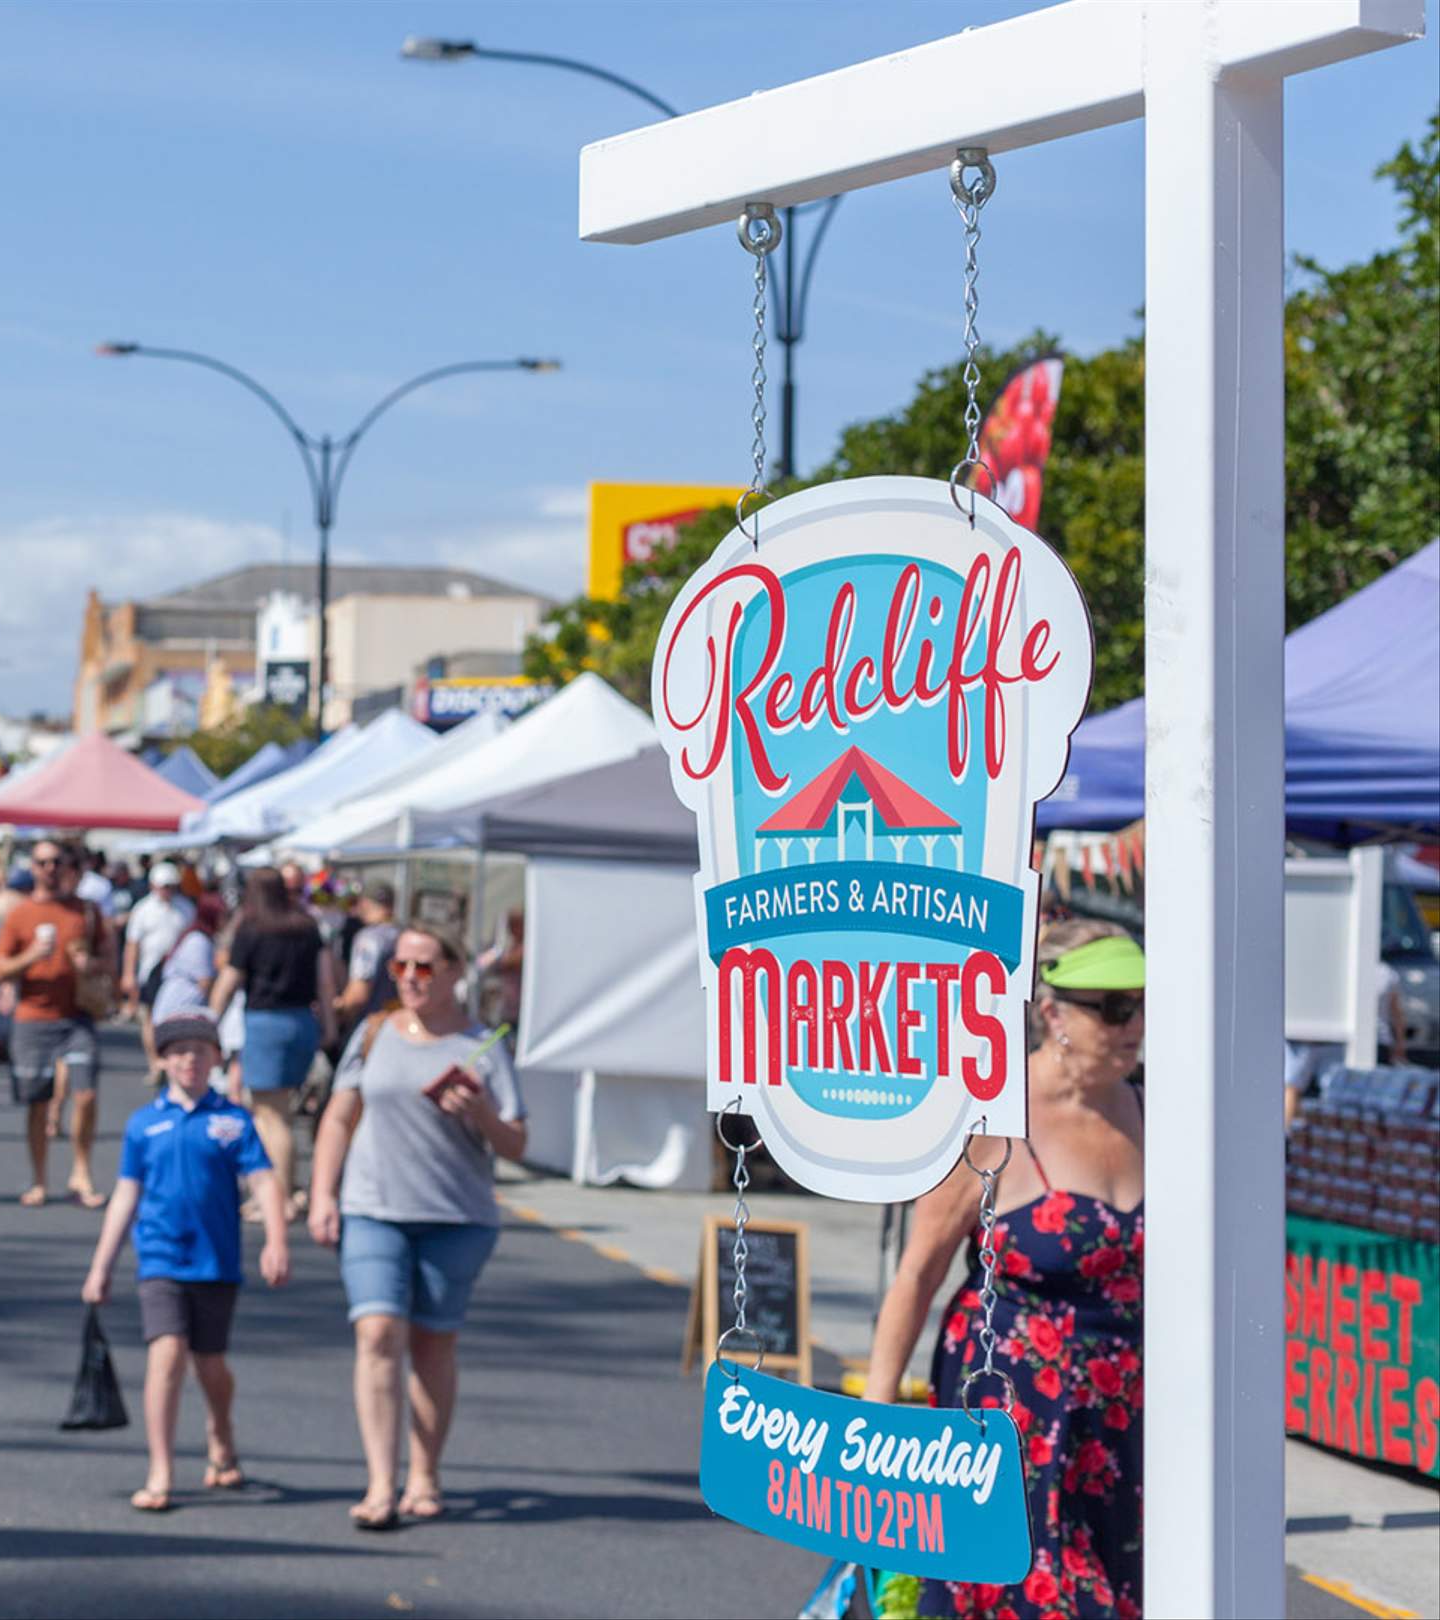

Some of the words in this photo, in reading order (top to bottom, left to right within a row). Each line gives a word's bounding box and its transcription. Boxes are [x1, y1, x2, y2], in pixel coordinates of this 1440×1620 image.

[663, 547, 1061, 792] Redcliffe
[724, 879, 840, 929] FARMERS
[848, 879, 865, 914] &
[871, 880, 990, 934] ARTISAN
[718, 947, 1009, 1103] MARKETS
[718, 1384, 829, 1474] Every
[839, 1417, 1002, 1505] Sunday
[767, 1458, 831, 1534] 8AM
[836, 1480, 873, 1544] TO
[877, 1490, 945, 1553] 2PM
